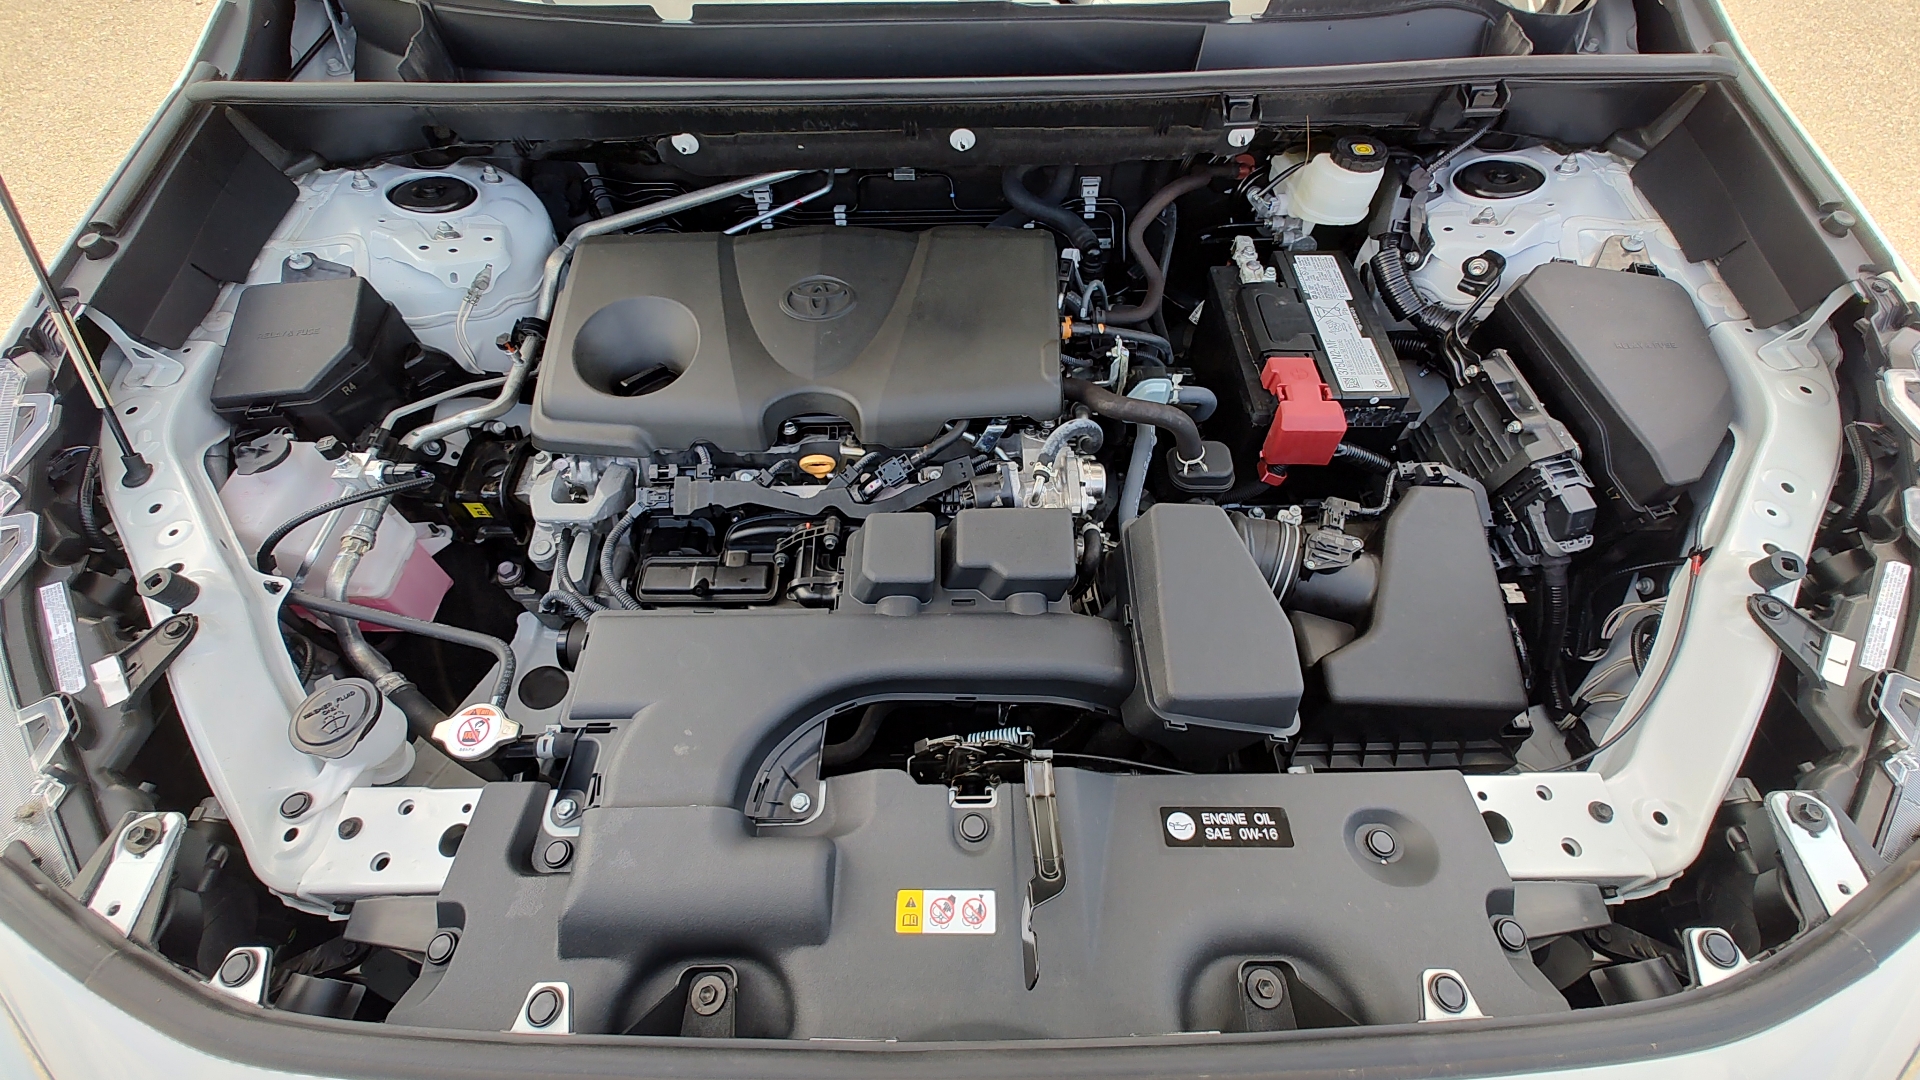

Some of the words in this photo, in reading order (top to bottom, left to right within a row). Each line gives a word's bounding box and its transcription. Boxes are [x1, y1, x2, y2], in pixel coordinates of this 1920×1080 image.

[341, 381, 358, 396] R4
[1605, 486, 1621, 500] L7
[1201, 812, 1248, 825] ENGINE
[1253, 812, 1276, 825] OIL
[1205, 827, 1232, 841] SAE
[1238, 827, 1279, 841] 0W-16
